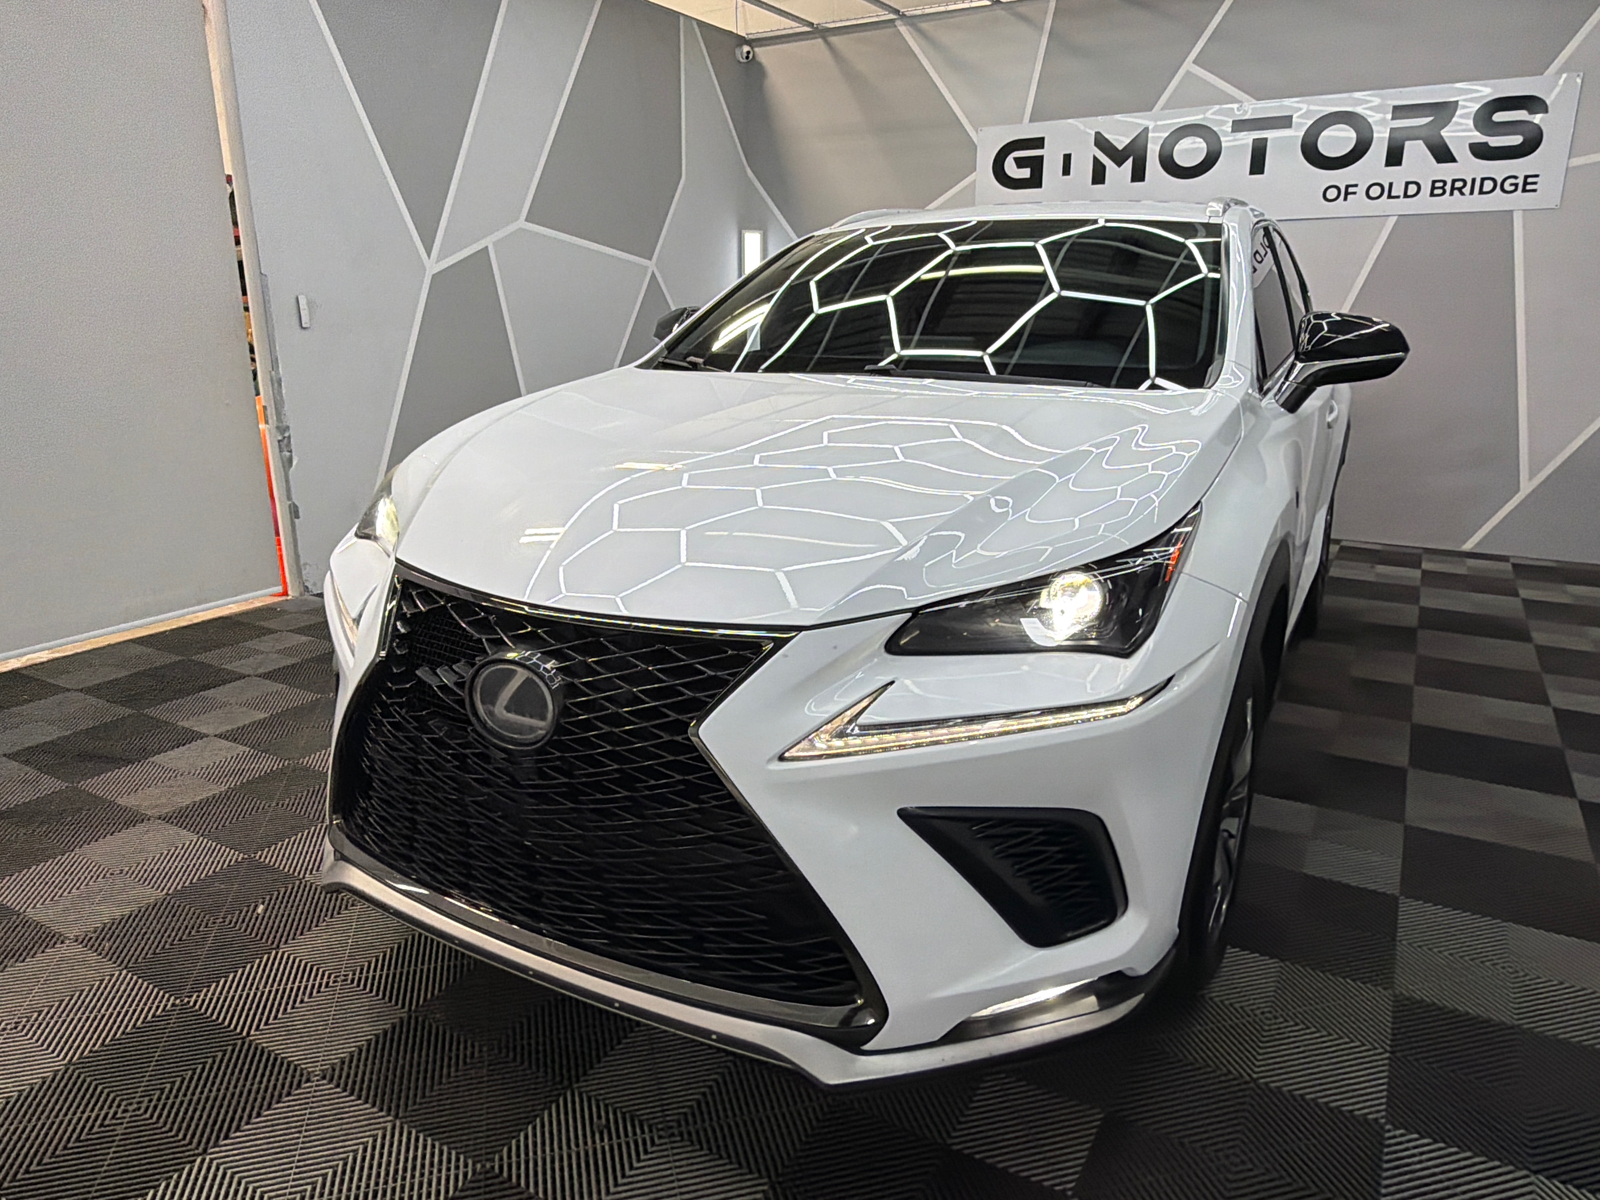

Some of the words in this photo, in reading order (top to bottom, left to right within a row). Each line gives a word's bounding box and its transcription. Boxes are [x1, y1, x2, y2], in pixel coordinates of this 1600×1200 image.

[1322, 184, 1358, 203] OF
[1365, 180, 1422, 200] OLD
[1429, 174, 1540, 198] BRIDGE
